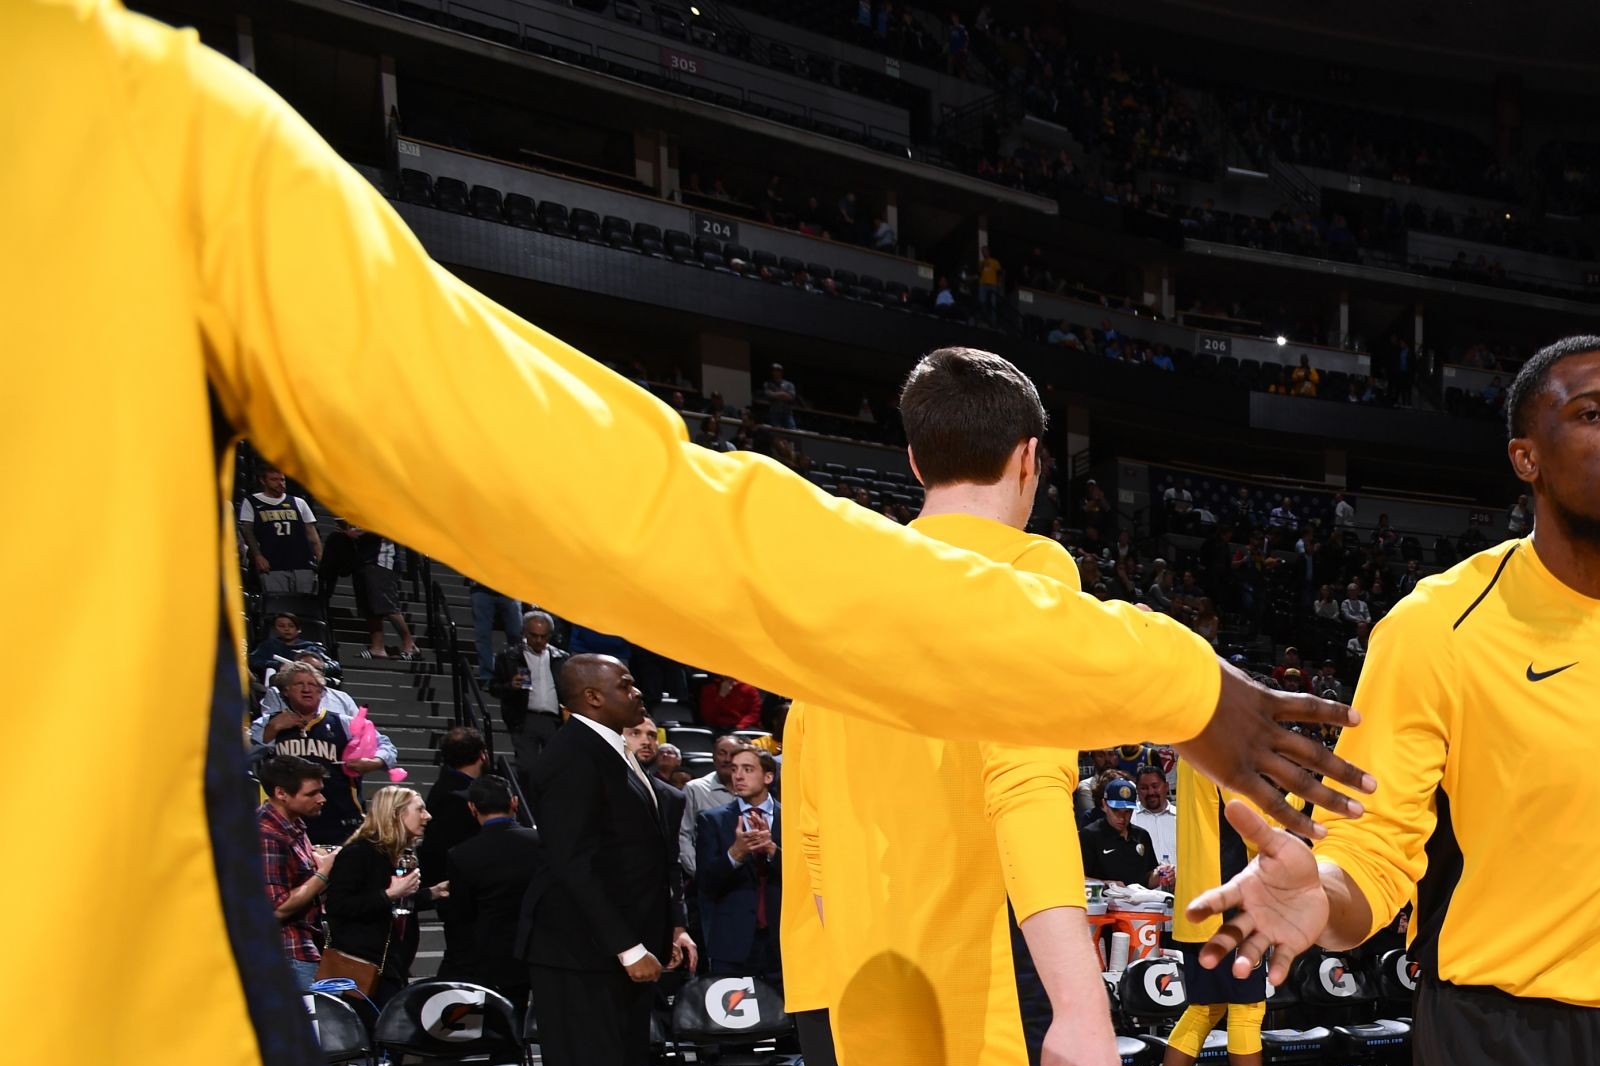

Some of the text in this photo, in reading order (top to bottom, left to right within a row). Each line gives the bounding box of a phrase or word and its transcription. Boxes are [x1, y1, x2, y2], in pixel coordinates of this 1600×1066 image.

[671, 55, 698, 73] 305
[703, 220, 731, 237] 204
[1204, 338, 1227, 351] 206
[274, 521, 292, 537] 27
[276, 738, 342, 764] INDIANA
[1138, 924, 1158, 947] G
[1143, 962, 1188, 1007] G
[1318, 957, 1358, 998] G
[704, 976, 761, 1029] G
[420, 989, 486, 1042] G
